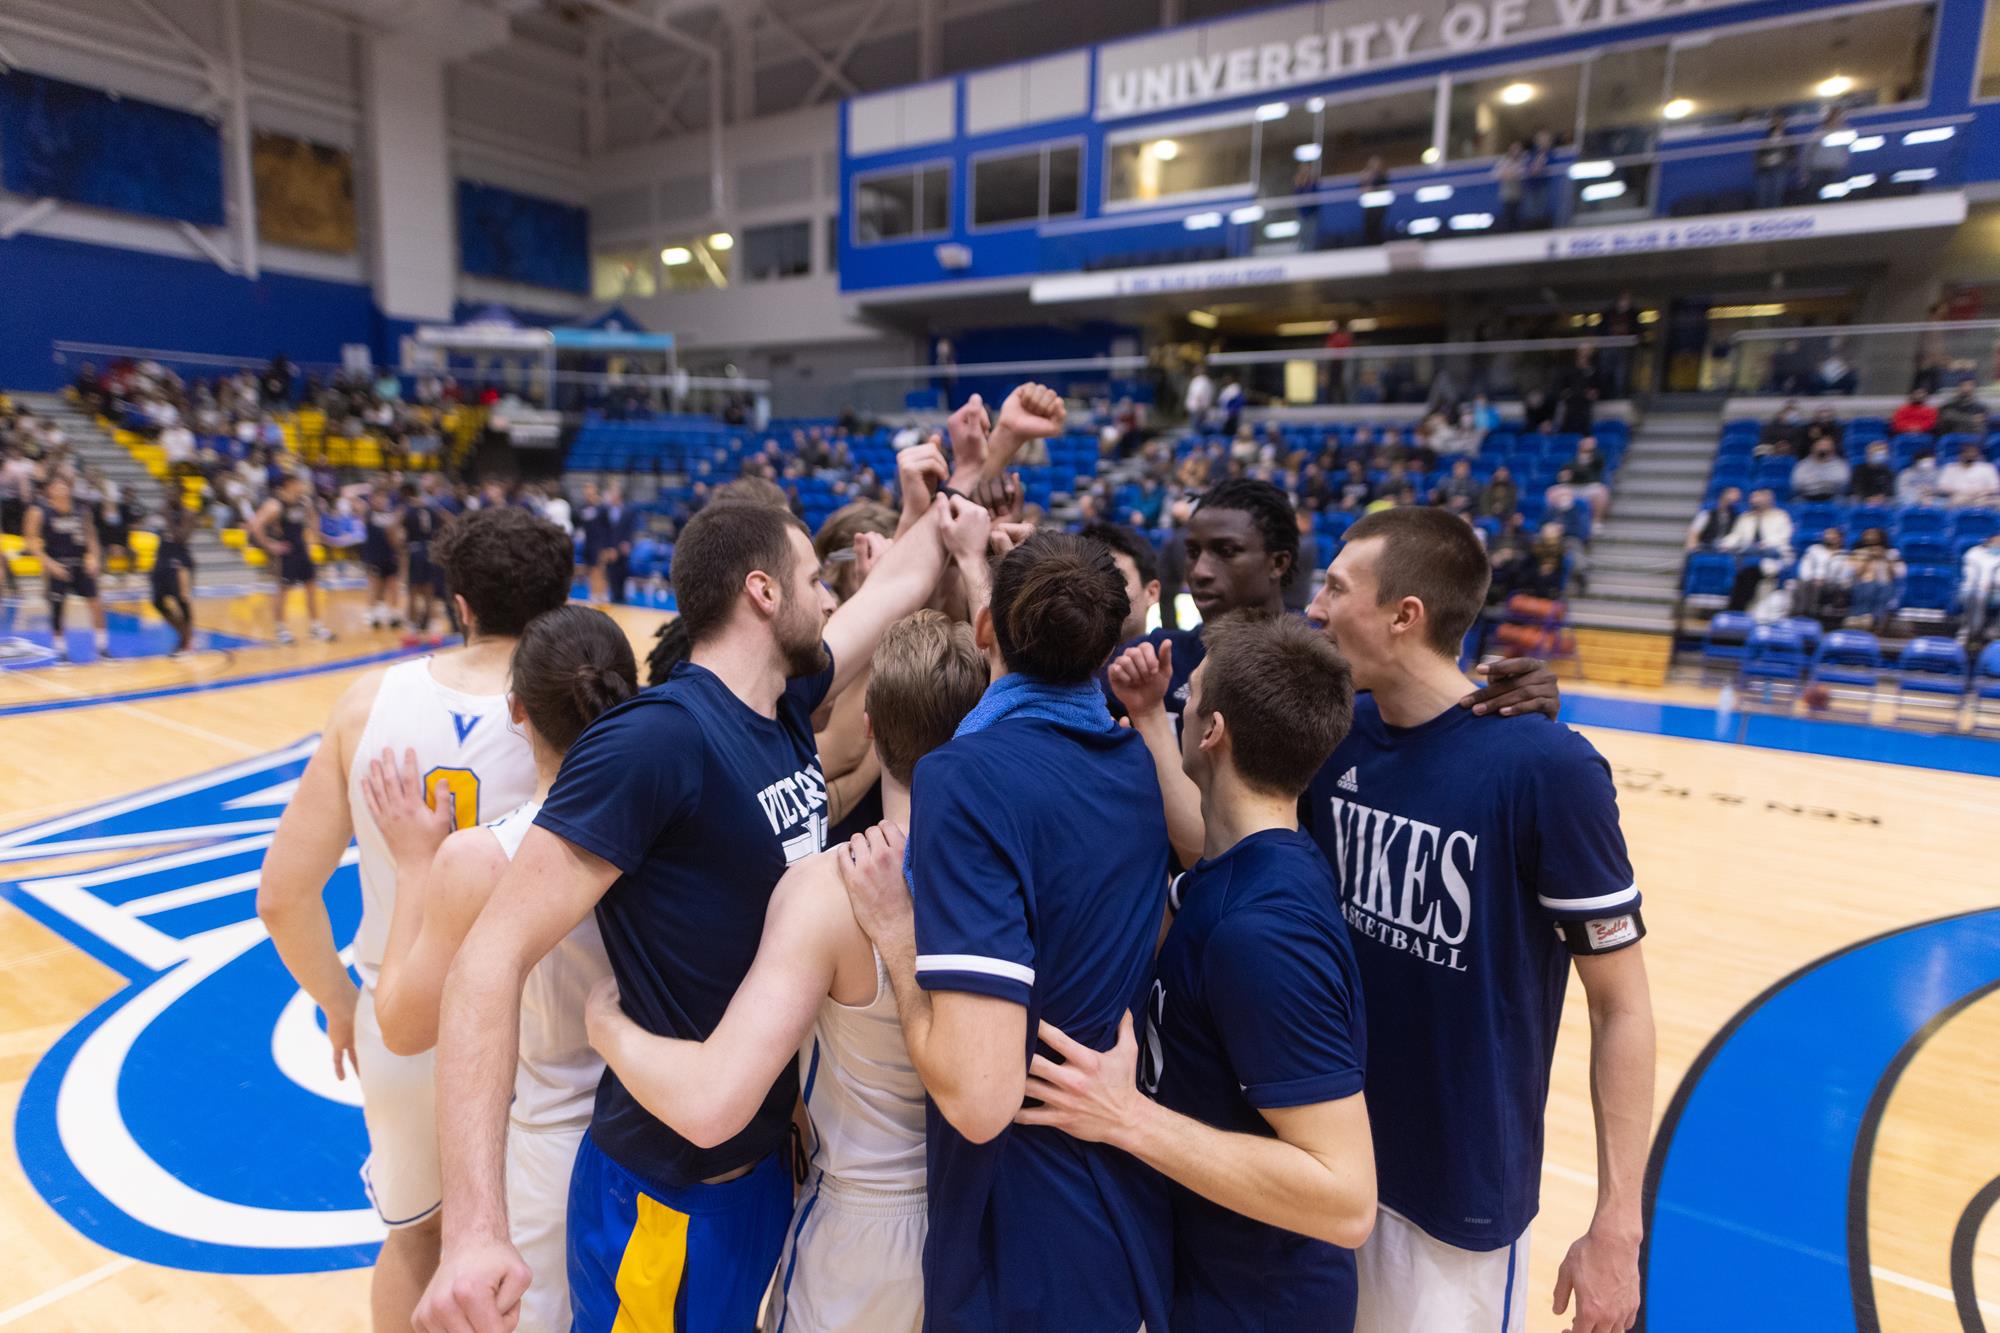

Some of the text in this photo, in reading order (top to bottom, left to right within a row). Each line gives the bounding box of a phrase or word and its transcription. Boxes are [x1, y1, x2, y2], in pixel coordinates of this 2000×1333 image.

[1105, 15, 1422, 111] UNIVERSITY
[1440, 0, 1526, 49] OF
[1330, 796, 1478, 945] VIKES
